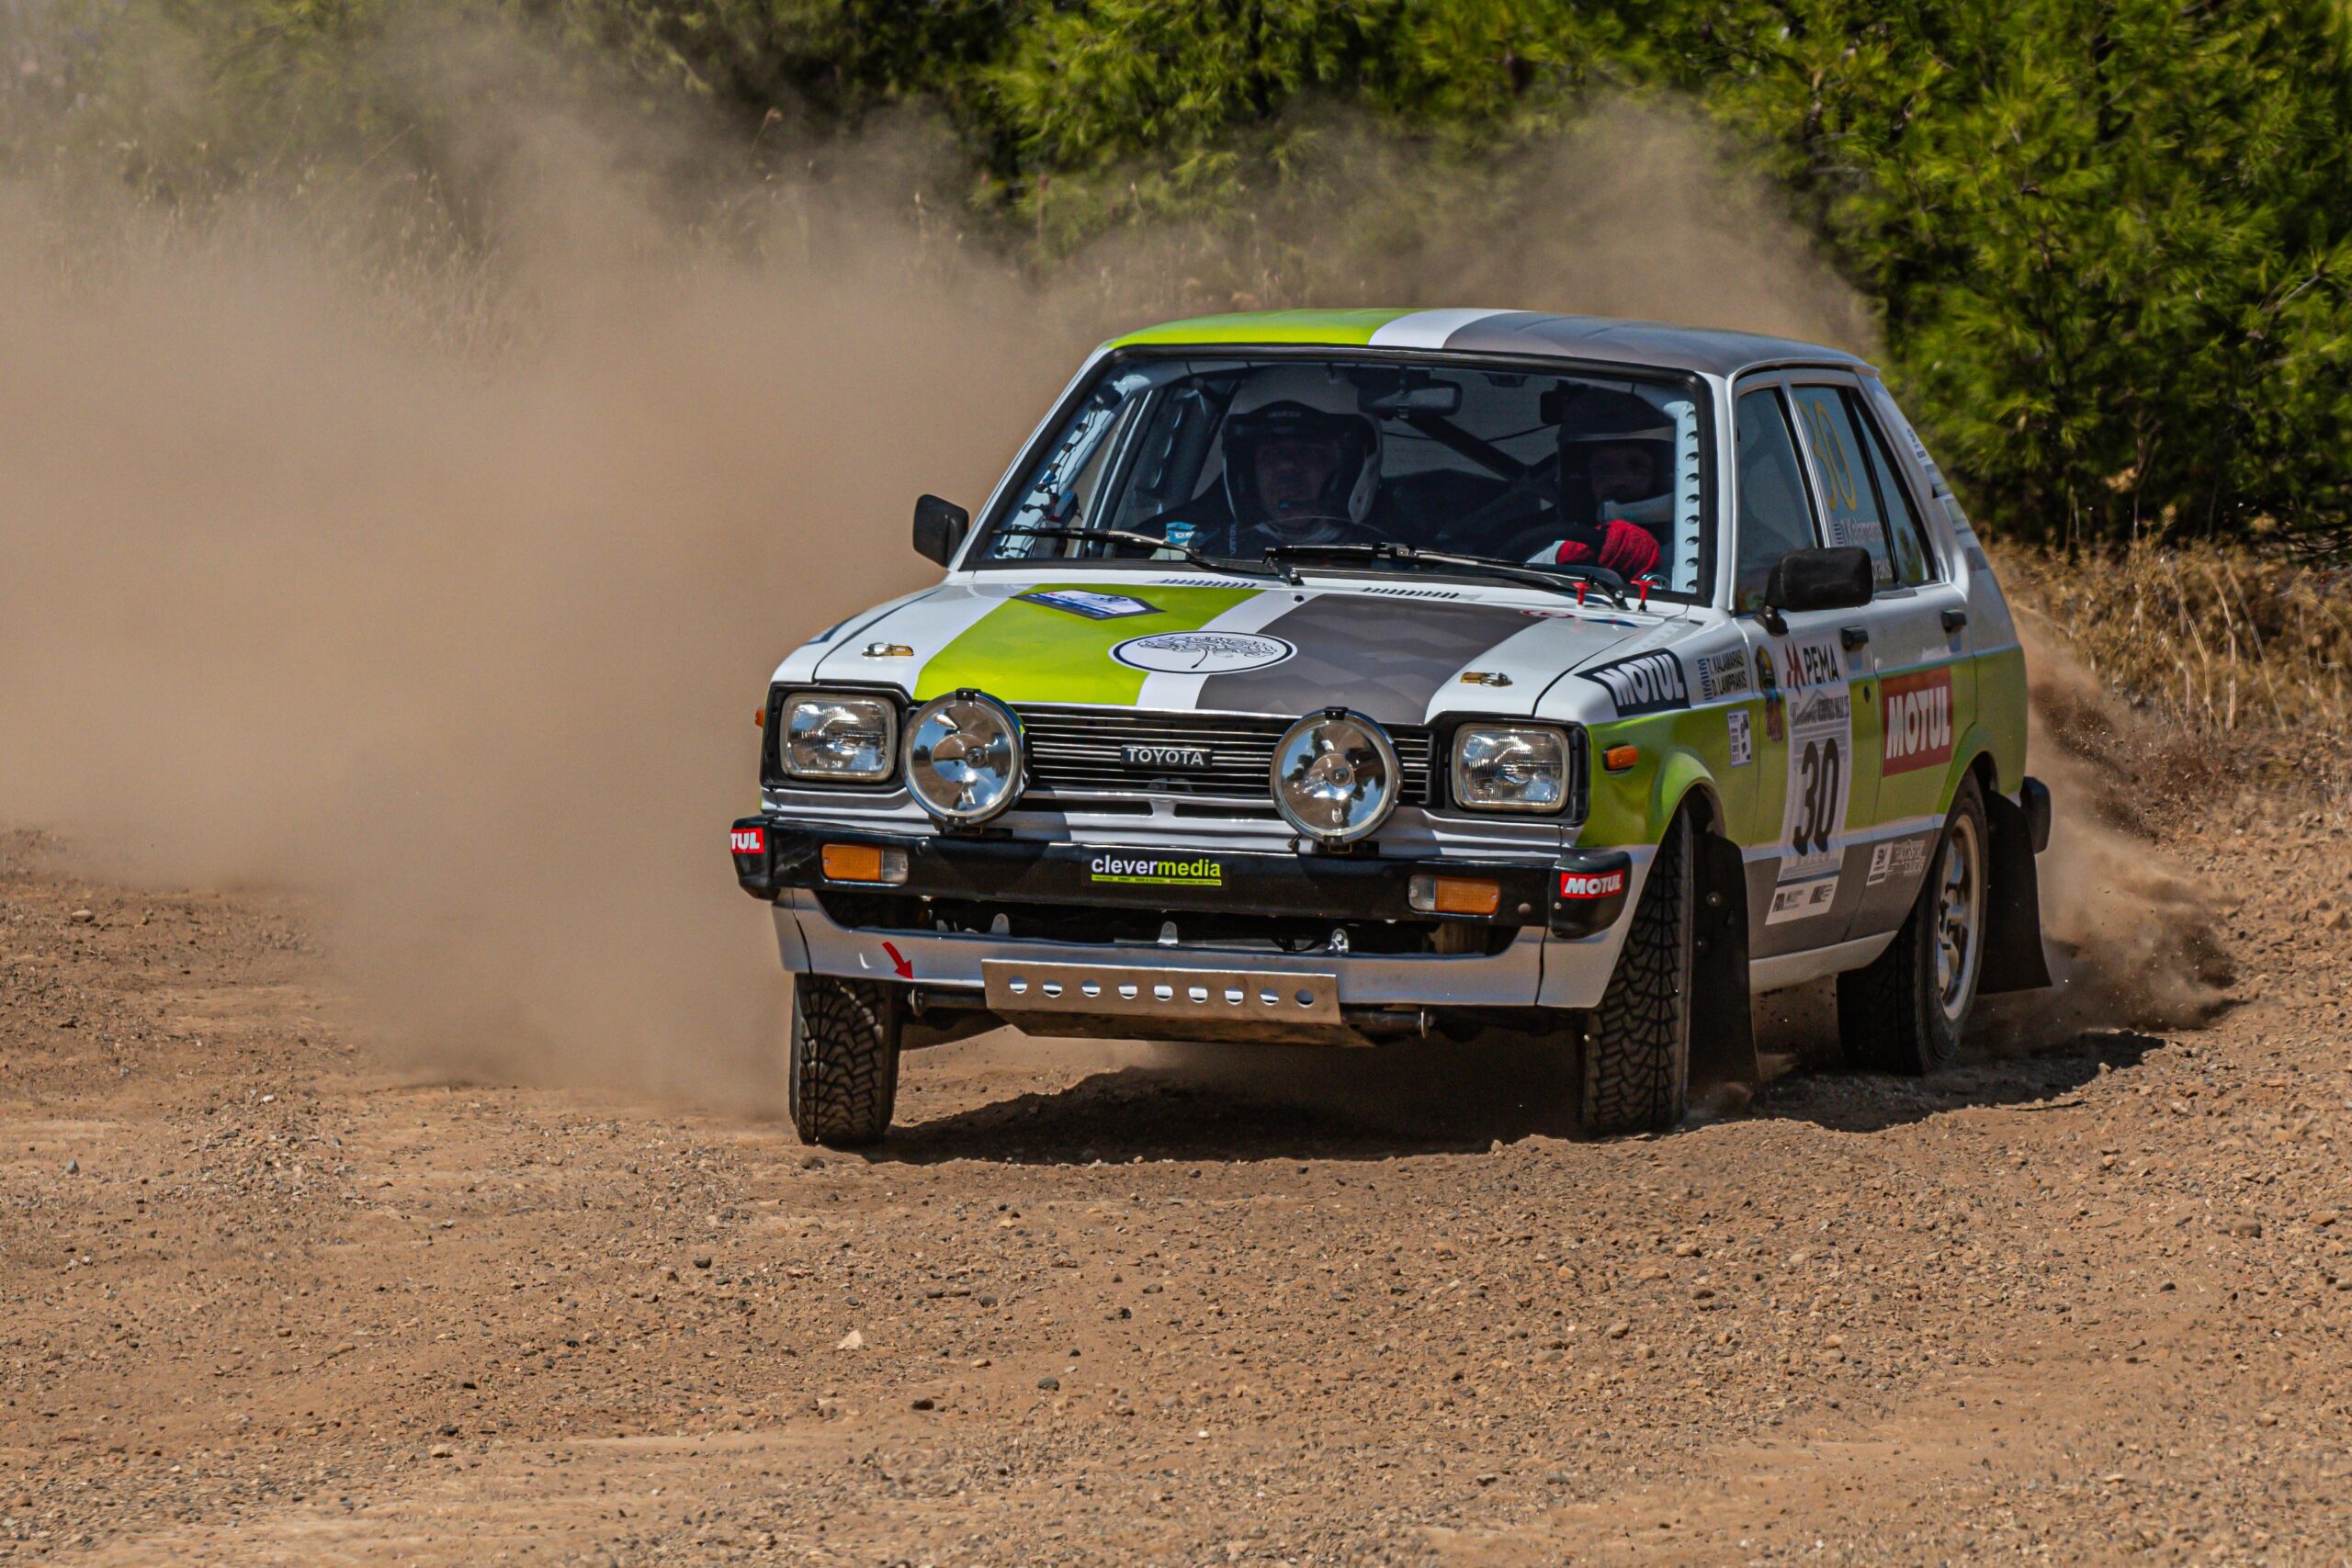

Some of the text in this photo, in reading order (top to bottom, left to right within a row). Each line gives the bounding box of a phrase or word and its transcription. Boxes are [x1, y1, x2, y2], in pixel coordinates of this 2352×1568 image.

[1796, 399, 1857, 512] 30
[1592, 653, 1685, 706] MOTUL
[1717, 670, 1747, 695] LAMPRAKIS
[1803, 644, 1840, 685] PEMA
[1885, 685, 1951, 760] MOTUL
[1126, 748, 1204, 765] TOYOTA
[1792, 738, 1839, 856] 30
[1091, 854, 1222, 877] clevermedia
[1565, 874, 1623, 895] MOTUL
